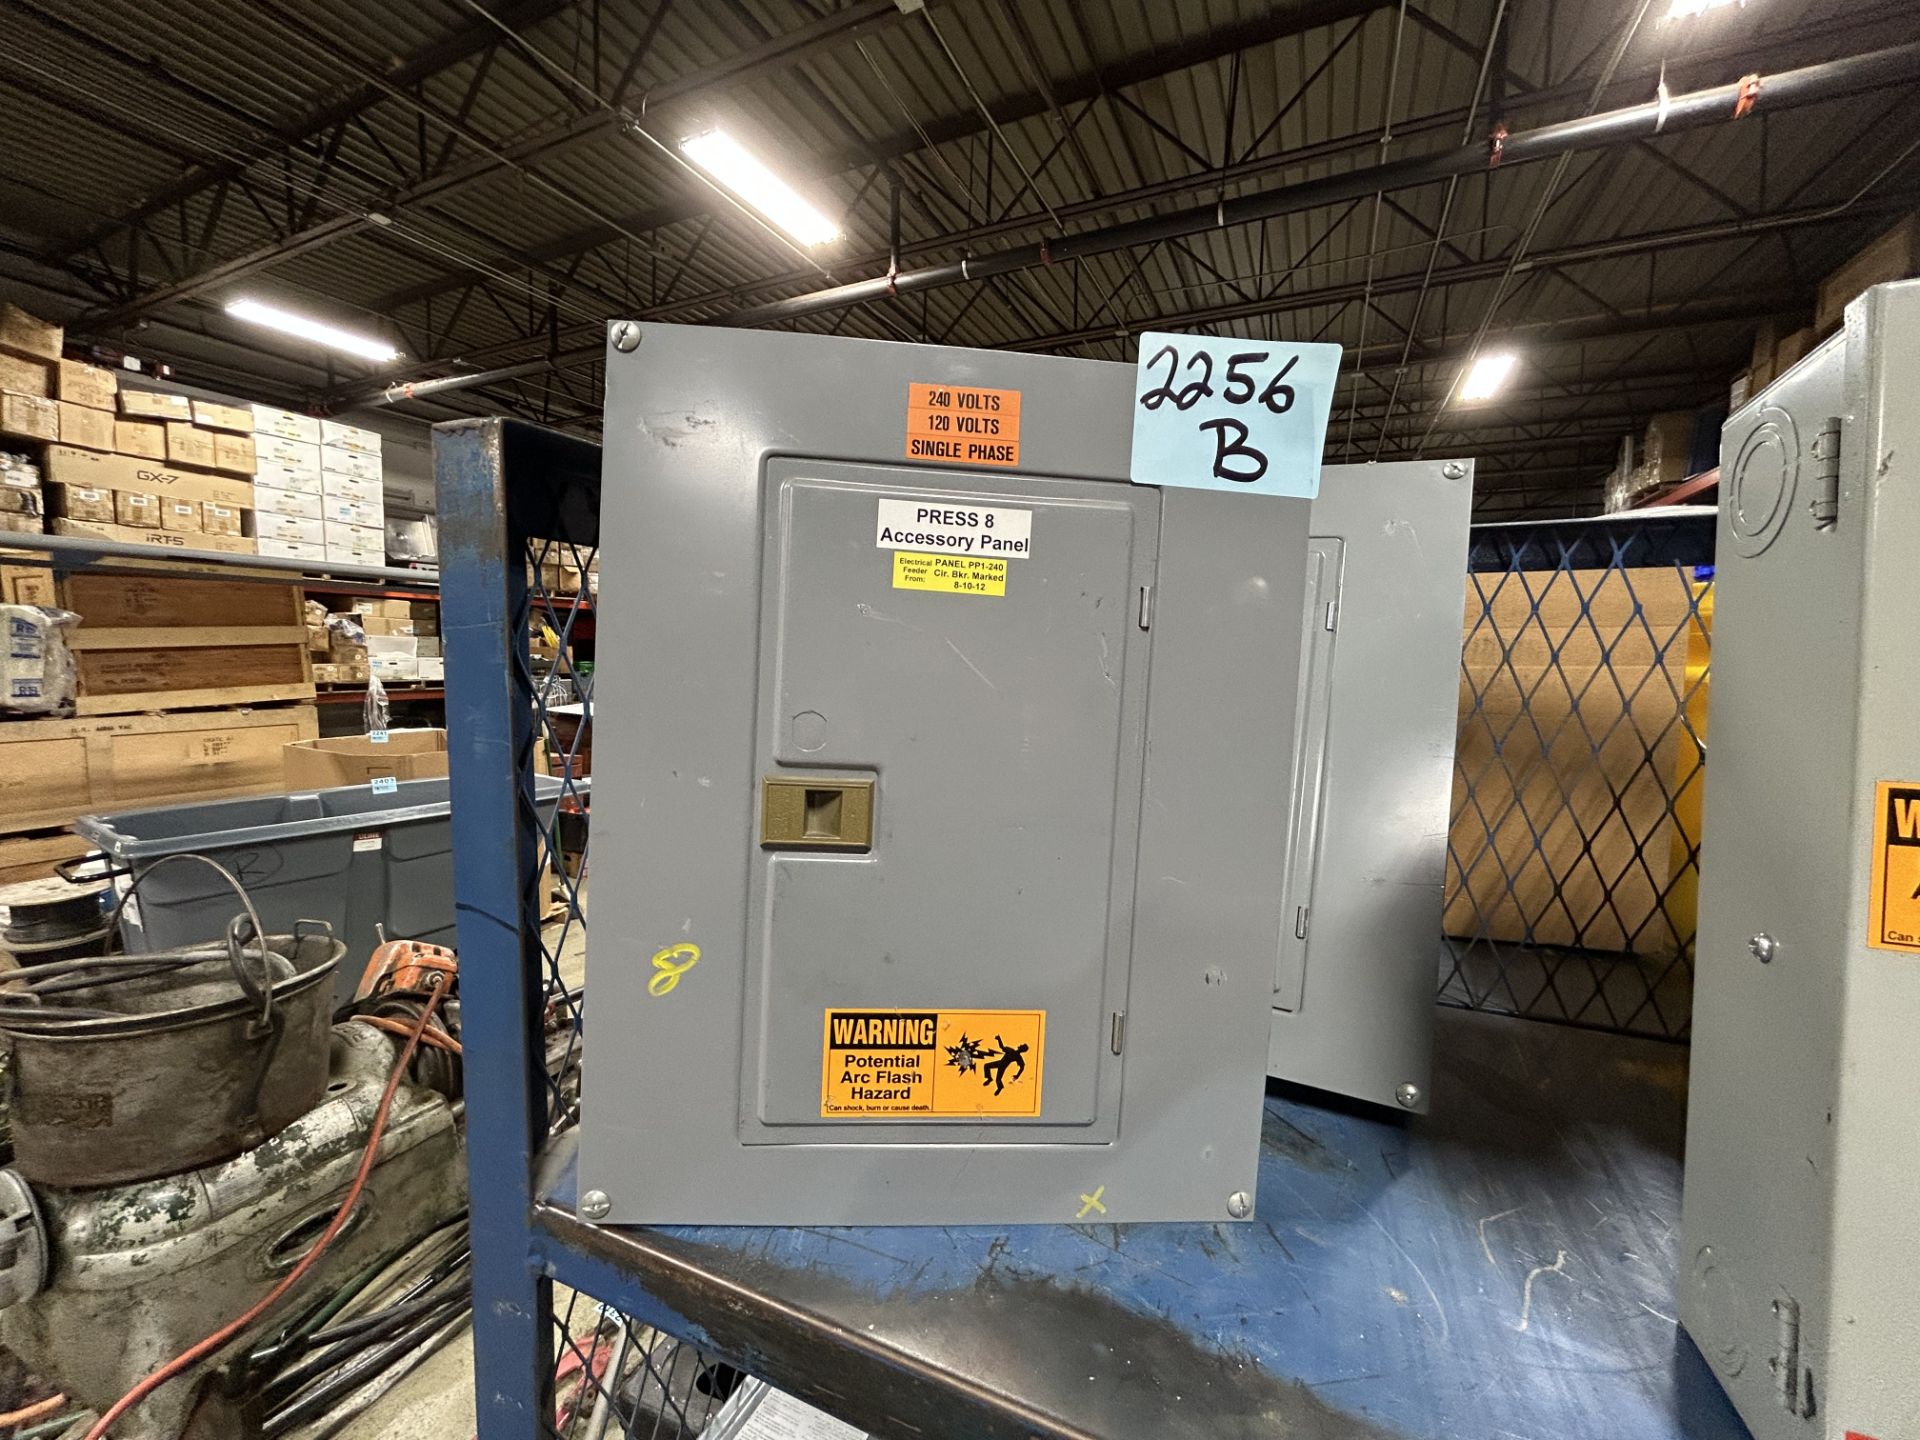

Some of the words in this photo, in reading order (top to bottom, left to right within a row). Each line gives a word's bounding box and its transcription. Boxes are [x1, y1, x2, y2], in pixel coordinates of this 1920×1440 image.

[1140, 344, 1299, 414] 2256
[928, 390, 951, 408] 240
[957, 392, 1000, 411] VOLTS
[928, 415, 950, 431] 120
[956, 416, 999, 434] VOLTS
[911, 439, 962, 458] SINGLE
[968, 443, 1014, 461] PHASE
[1199, 417, 1268, 482] B
[137, 469, 180, 484] GX-7
[917, 508, 979, 527] PRESS
[984, 513, 995, 528] 8
[880, 527, 974, 552] Accessory
[981, 534, 1029, 552] Panel
[899, 557, 933, 567] Electrical
[935, 559, 966, 568] PANEL
[968, 561, 1004, 571] PP1-240
[903, 567, 928, 575] Feeder
[933, 568, 949, 578] Cir.
[952, 570, 970, 579] Bkr.
[972, 571, 1004, 582] Marked
[905, 575, 926, 583] From:
[953, 581, 986, 591] 8-10-12
[1887, 931, 1914, 942] Can
[833, 1018, 936, 1045] WARNING
[845, 1054, 920, 1068] Potential
[840, 1070, 870, 1084] Arc
[876, 1070, 922, 1084] Flash
[851, 1086, 911, 1100] Hazard
[843, 1104, 865, 1112] shock,
